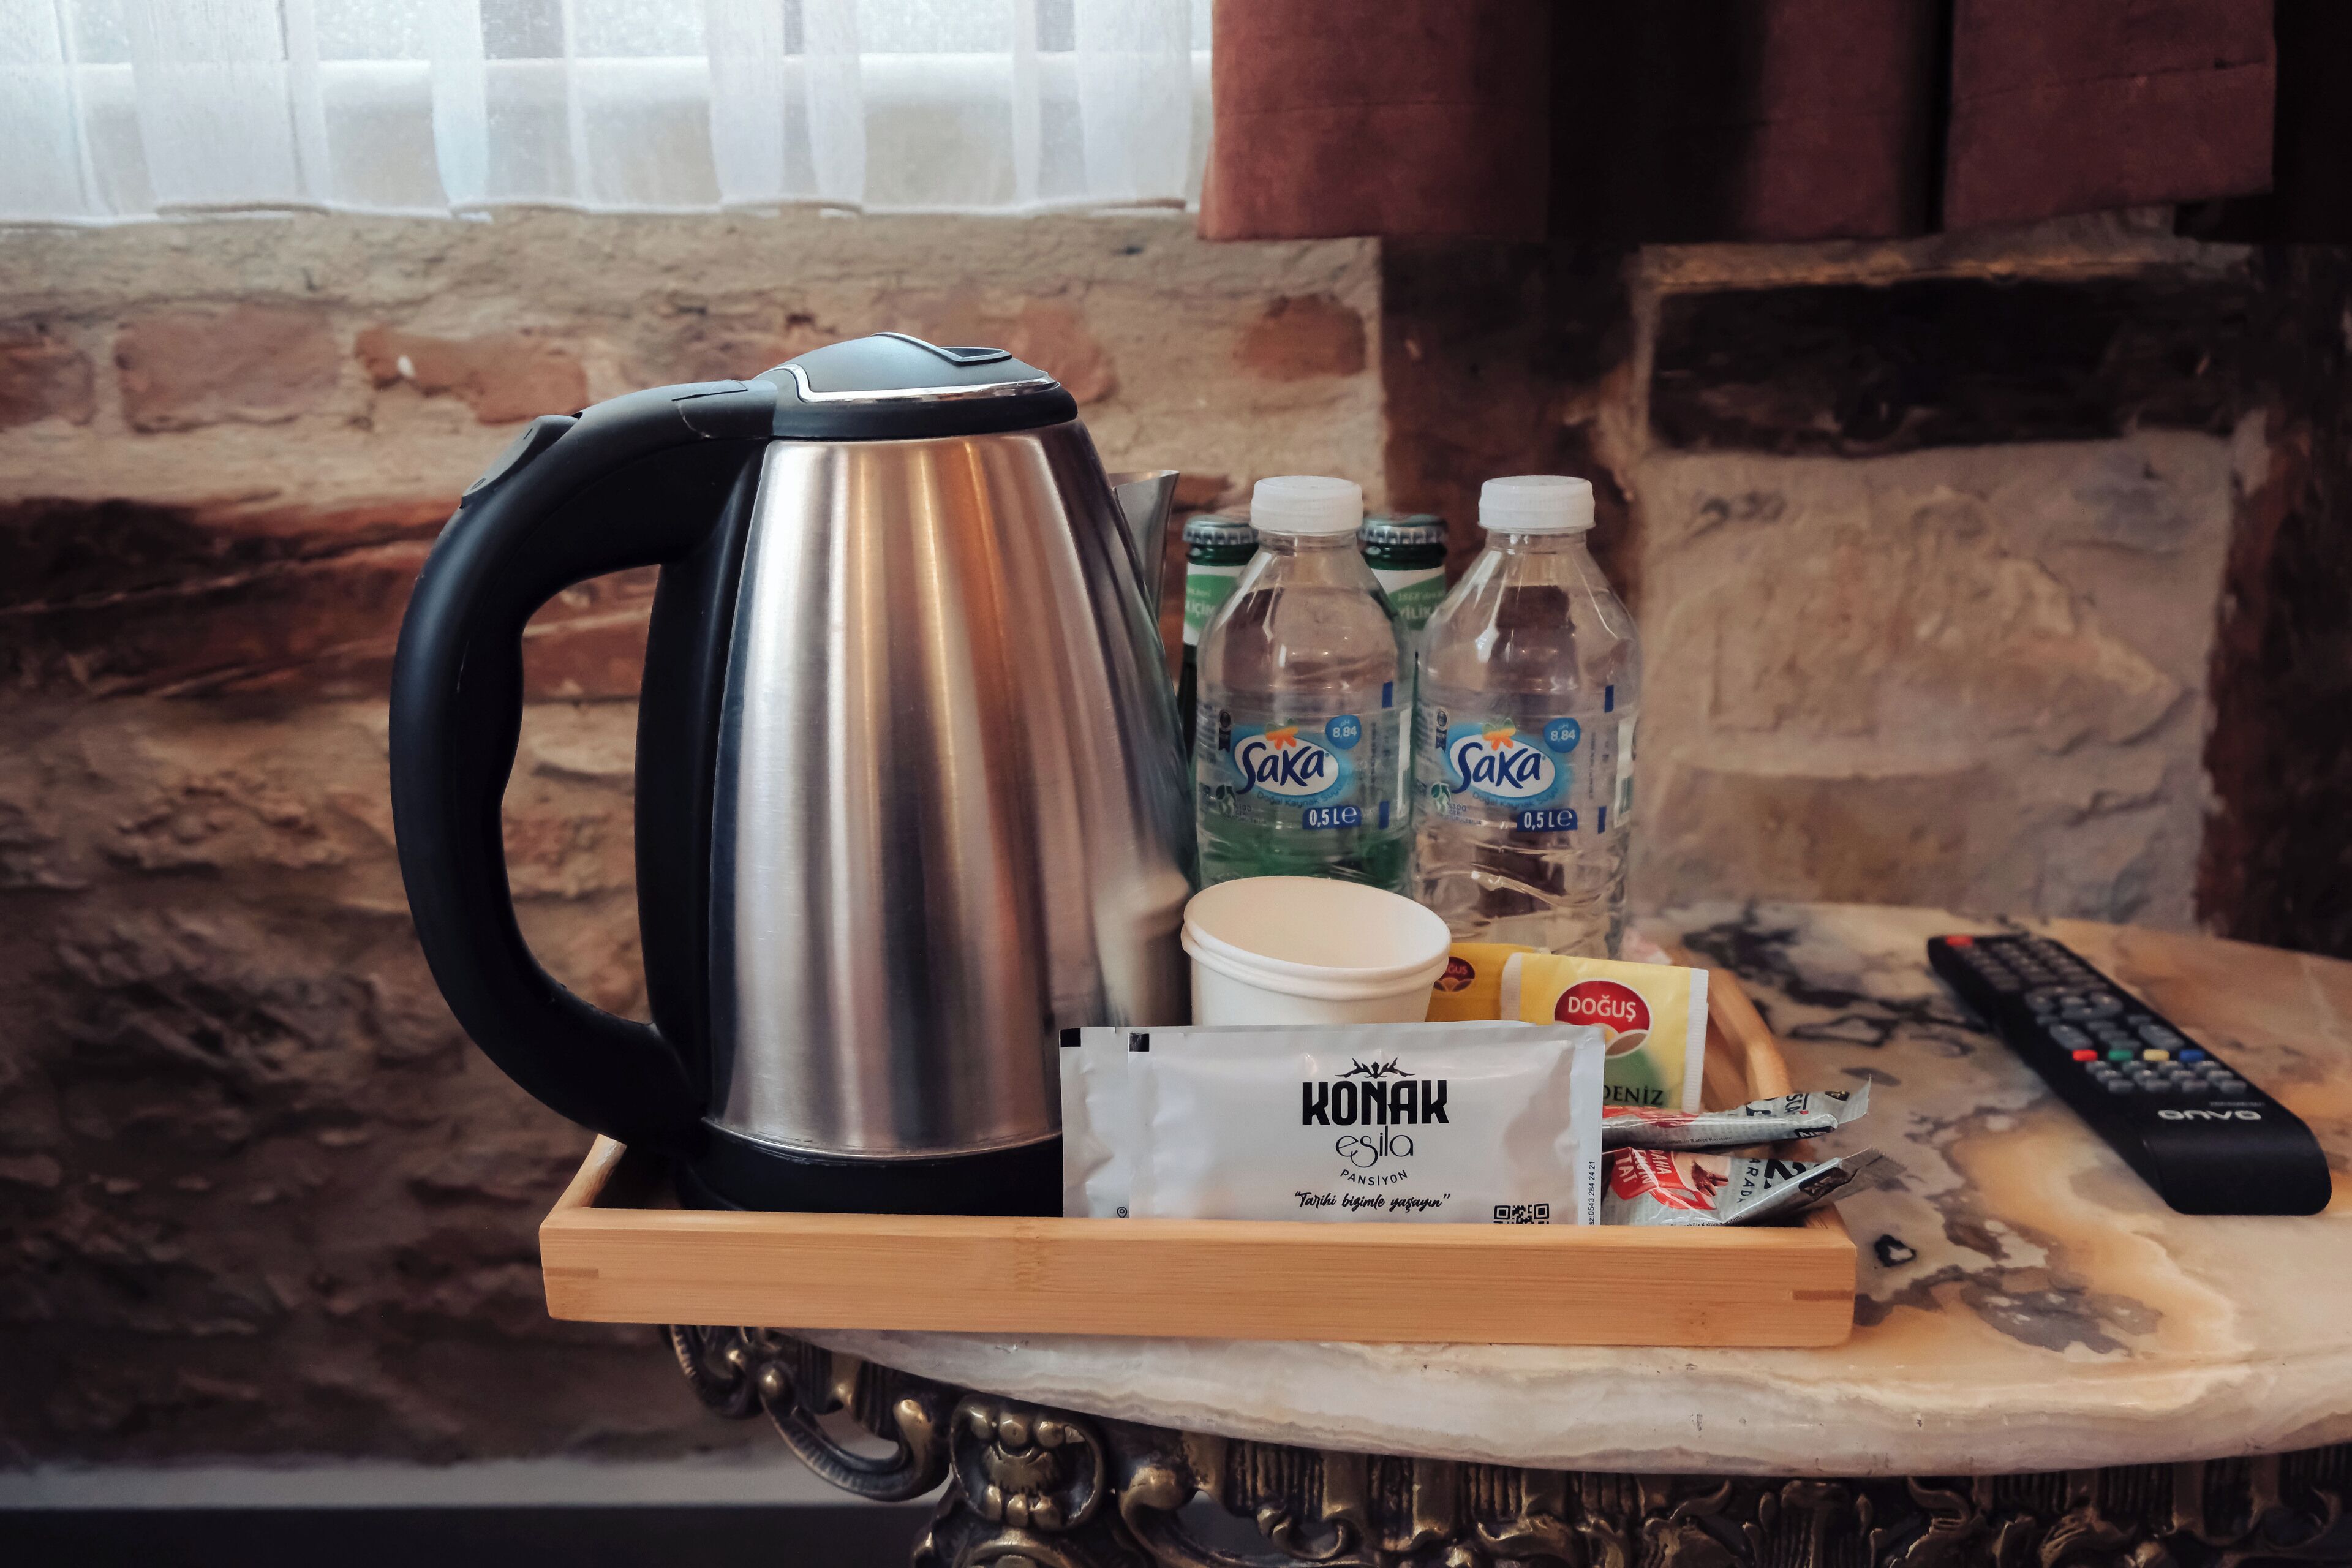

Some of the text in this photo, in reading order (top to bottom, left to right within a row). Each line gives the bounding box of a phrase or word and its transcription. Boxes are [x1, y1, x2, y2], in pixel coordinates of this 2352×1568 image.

[1333, 726, 1357, 738] 8,84
[1551, 730, 1575, 741] 8,84
[1568, 995, 1636, 1022] DOĞUŞ
[1302, 1080, 1449, 1126] KONAK
[1588, 1172, 1595, 1180] 24
